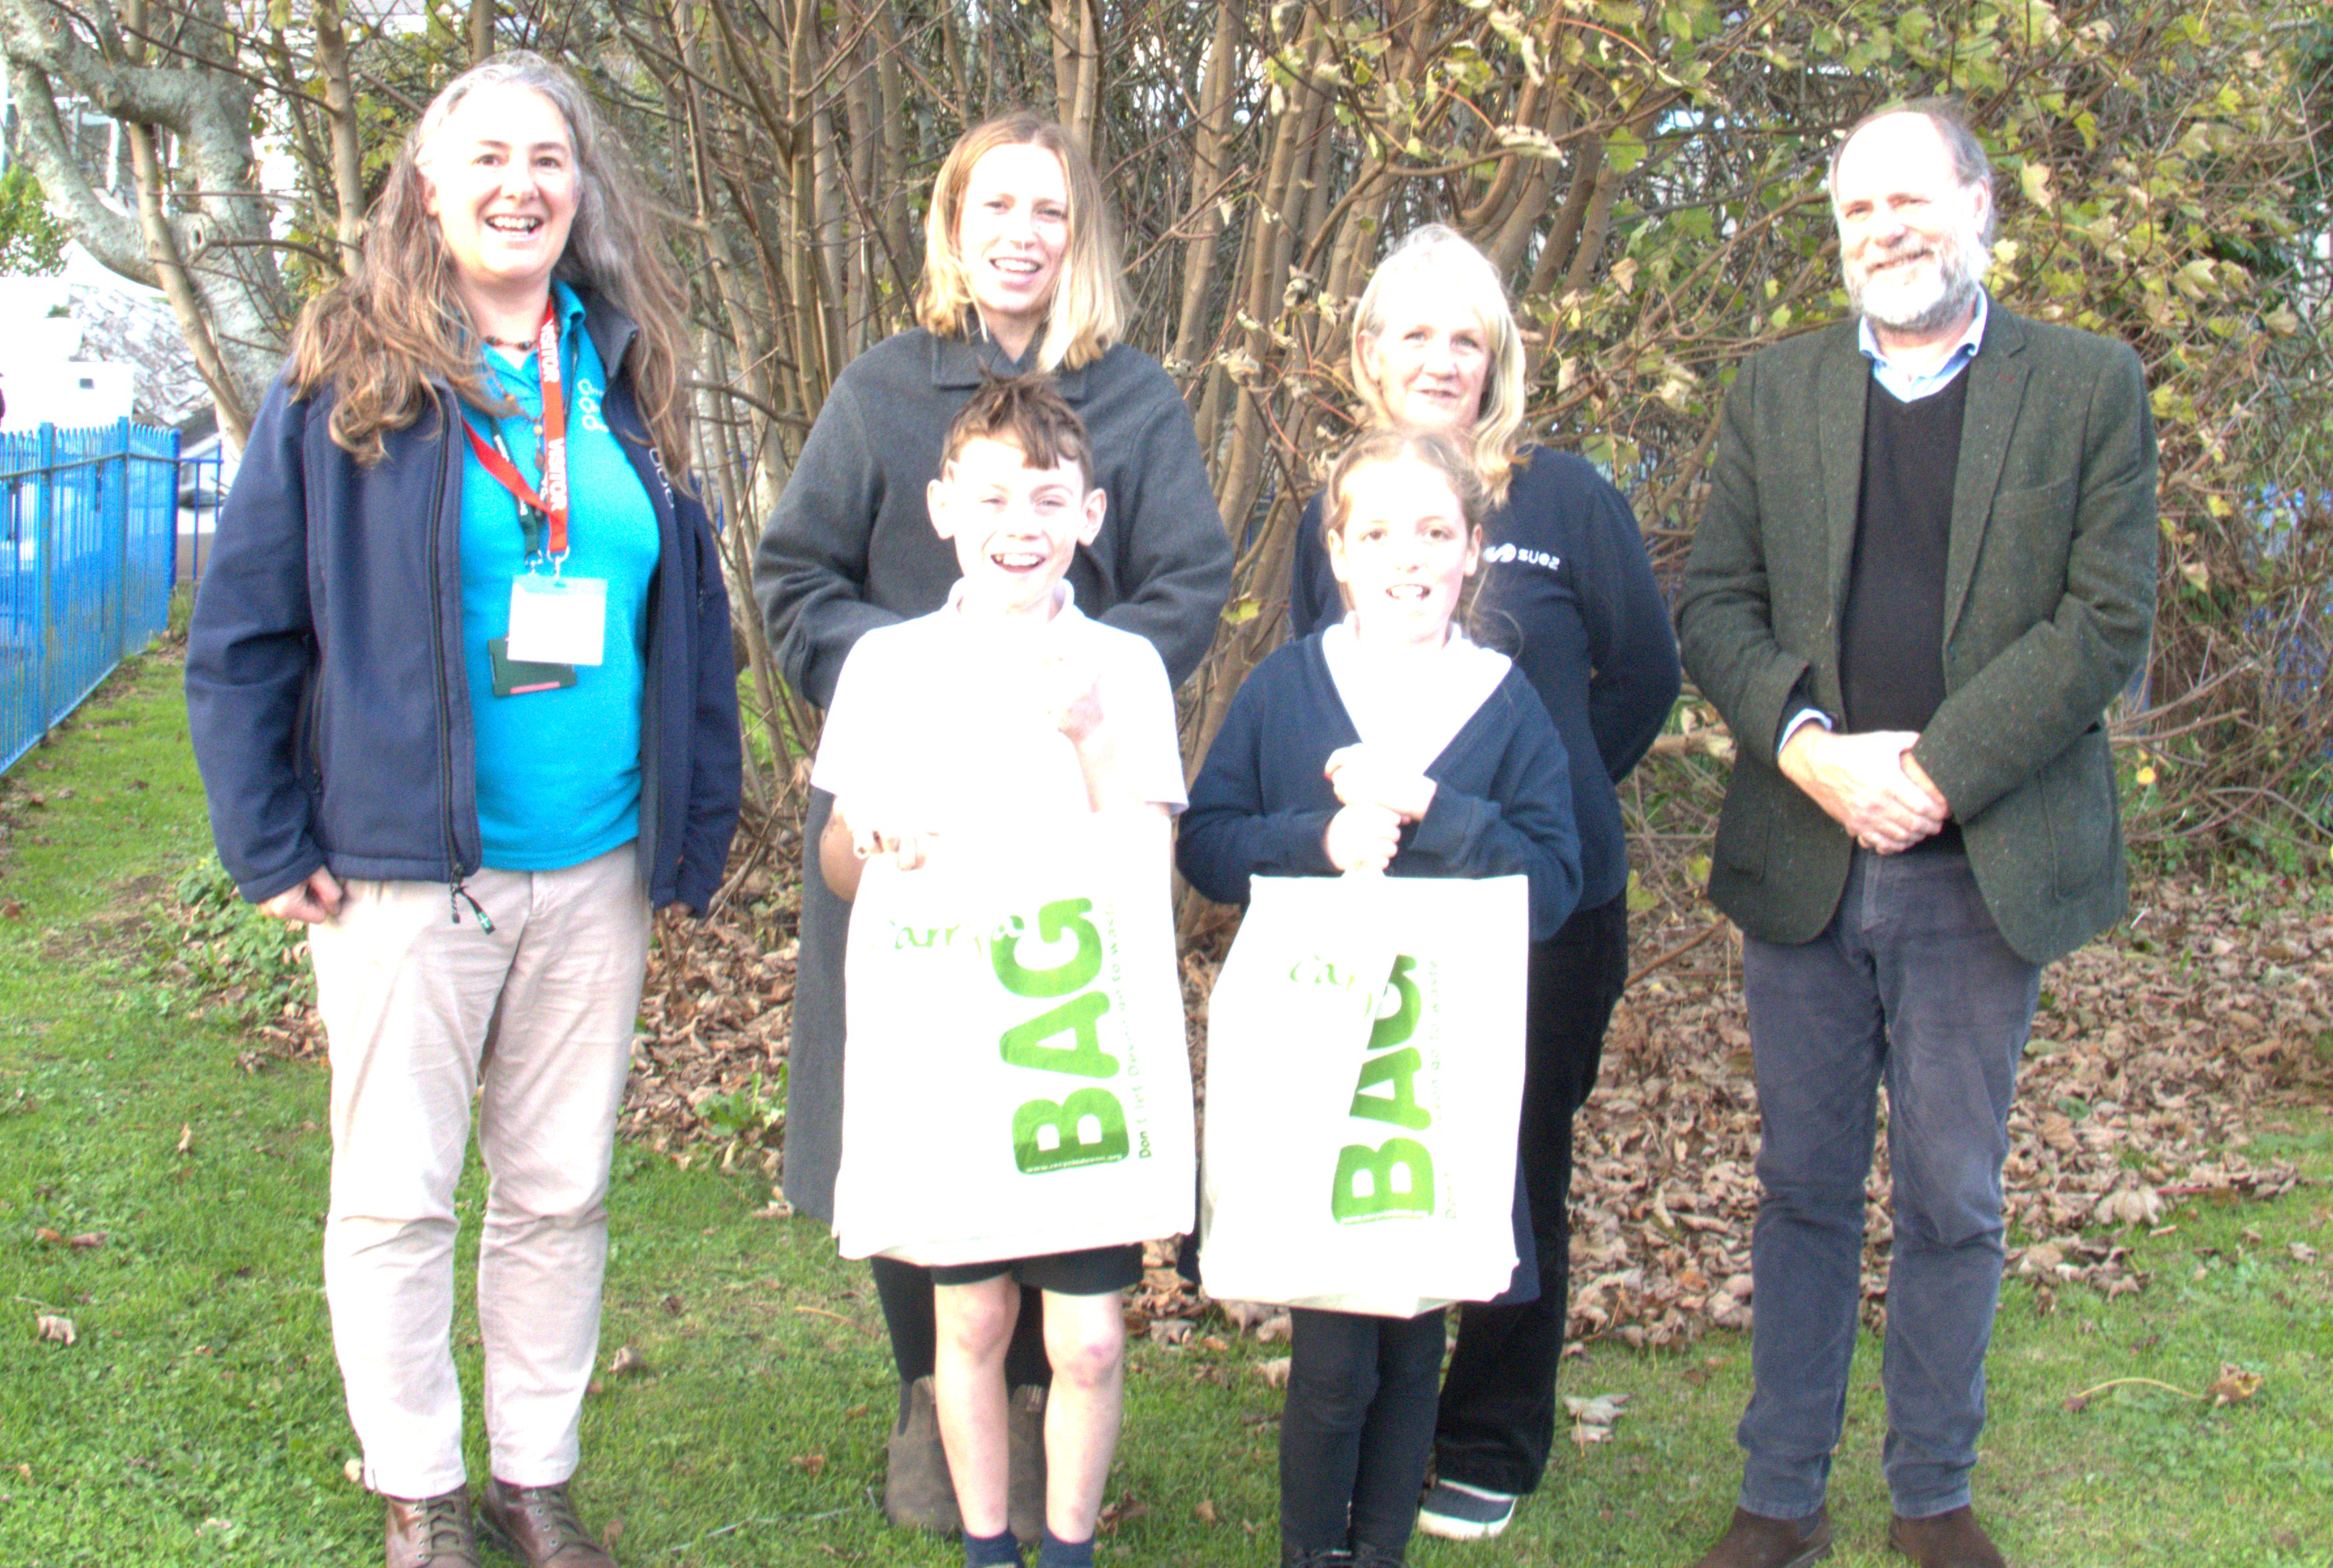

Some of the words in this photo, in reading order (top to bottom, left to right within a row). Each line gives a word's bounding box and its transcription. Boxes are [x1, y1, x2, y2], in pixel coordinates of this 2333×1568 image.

[539, 319, 560, 383] VISITOR
[548, 437, 567, 511] VISITOR
[869, 919, 983, 961] arr
[1105, 898, 1119, 956] wast
[1111, 963, 1121, 982] to
[990, 897, 1131, 1175] BAG
